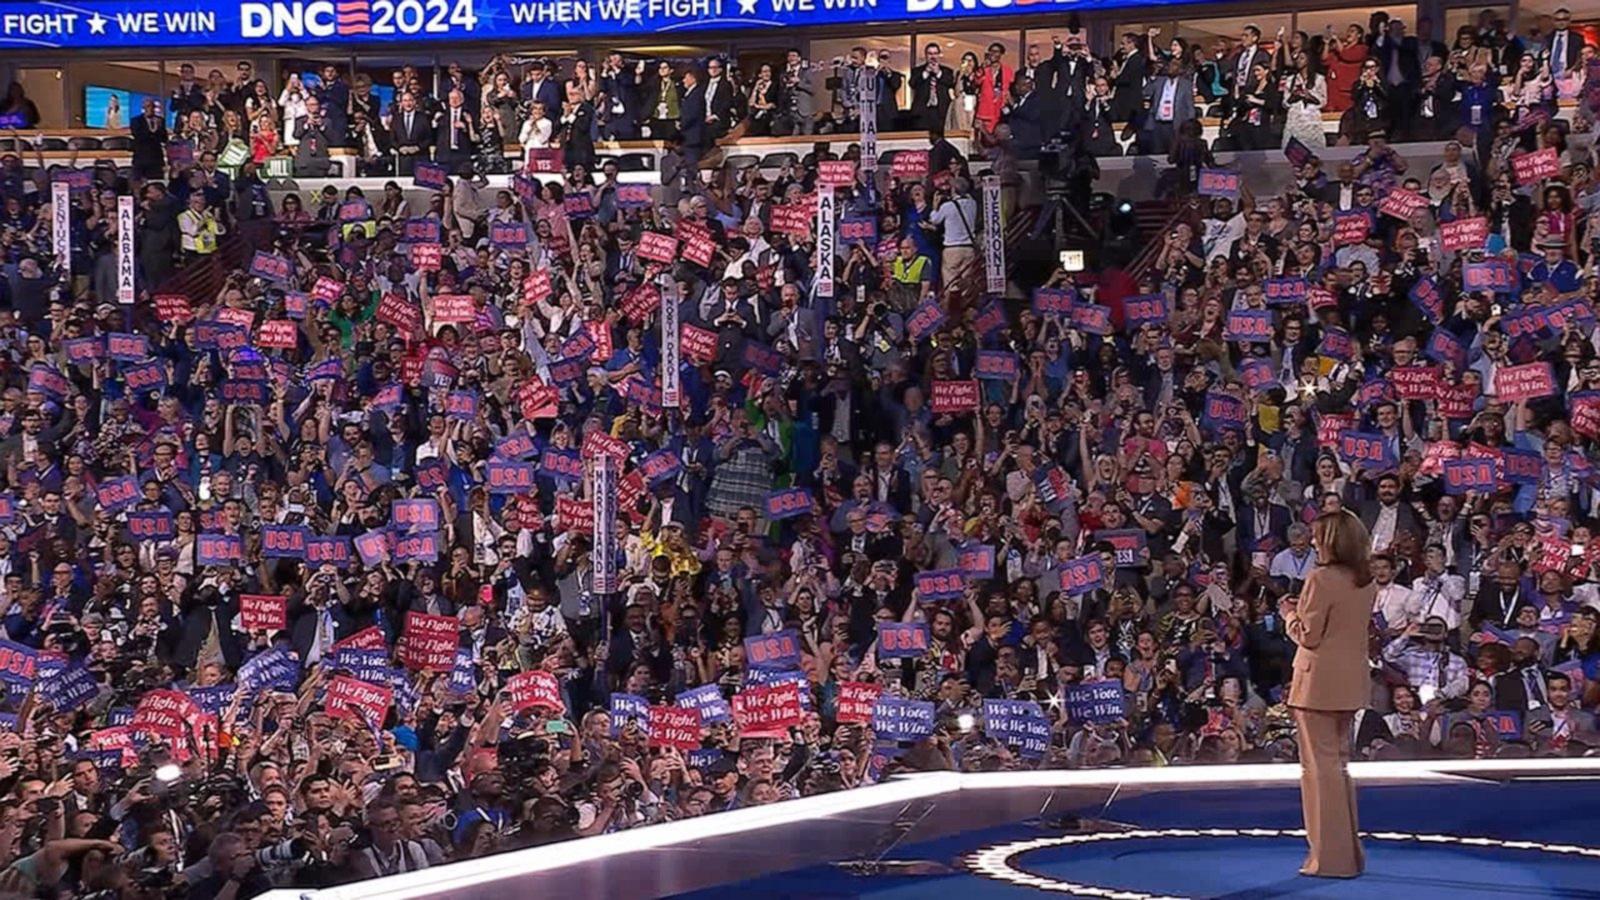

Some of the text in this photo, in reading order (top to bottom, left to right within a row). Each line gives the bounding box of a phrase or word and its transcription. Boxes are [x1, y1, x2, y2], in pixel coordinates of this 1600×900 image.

[371, 0, 478, 34] 2024
[510, 3, 592, 23] WHEN
[600, 0, 641, 20] WE
[649, 0, 722, 17] FIGHT
[4, 12, 215, 34] FIGHT WE WIN
[866, 77, 877, 156] UTAH
[267, 159, 289, 177] JILL
[1516, 153, 1555, 170] We Fight.
[1519, 164, 1558, 179] We Win.
[820, 197, 832, 280] ALASKA
[989, 189, 1002, 276] VERMONT
[121, 208, 132, 288] ALABAMA
[1467, 268, 1508, 287] USA
[1230, 316, 1266, 335] USA
[1405, 372, 1435, 383] Fight.
[1499, 369, 1546, 384] We Fight.
[935, 384, 974, 396] We Fight.
[1409, 385, 1435, 394] Win.
[1501, 381, 1547, 396] We Win.
[935, 395, 977, 406] We Win.
[1344, 438, 1384, 462] USA
[491, 468, 528, 485] USA
[1450, 465, 1493, 487] USA
[768, 492, 810, 511] USA
[395, 504, 435, 524] USA
[130, 518, 170, 535] USA
[265, 530, 303, 550] USA
[201, 541, 242, 560] USA
[308, 543, 346, 561] USA
[1060, 560, 1099, 589] USA
[920, 572, 963, 595] USA
[243, 599, 283, 612] We Fight.
[243, 612, 283, 625] We Win.
[411, 617, 425, 628] We
[426, 619, 455, 632] Fight.
[409, 637, 455, 652] We Fight.
[882, 629, 927, 650] USA
[751, 637, 794, 661] USA
[340, 653, 387, 667] We Vote.
[408, 651, 453, 665] We Win.
[456, 654, 472, 668] We
[360, 669, 386, 681] Win.
[453, 671, 471, 685] We
[336, 682, 353, 696] We
[353, 686, 386, 707] Fight.
[747, 686, 798, 707] We Fight.
[1070, 688, 1120, 702] We Vote.
[748, 705, 798, 724] We Win.
[877, 703, 930, 719] We Vote.
[988, 703, 1008, 716] We
[1071, 704, 1123, 719] We Win.
[662, 711, 697, 727] Fight.
[876, 720, 929, 735] We Win.
[989, 718, 1049, 736] We We Vote.
[665, 730, 695, 743] Win.
[1008, 736, 1048, 752] We Win.
